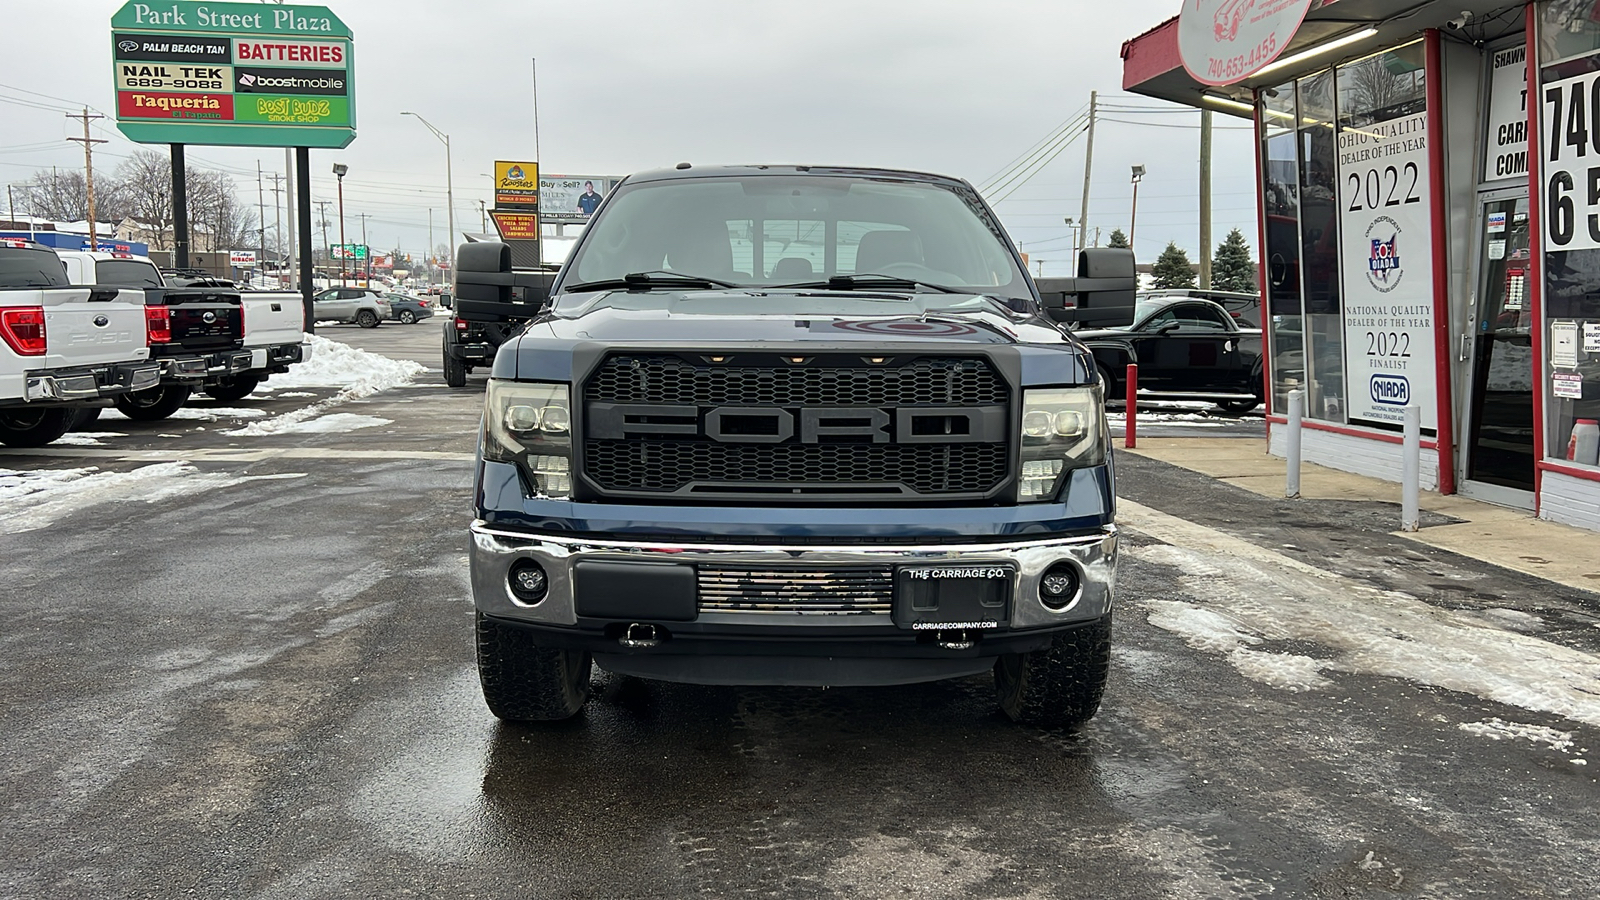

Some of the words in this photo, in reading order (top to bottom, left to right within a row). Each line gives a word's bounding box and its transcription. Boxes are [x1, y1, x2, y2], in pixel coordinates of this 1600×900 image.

[133, 3, 187, 25] Park
[196, 6, 263, 29] Street
[272, 9, 332, 32] Plaza
[142, 42, 169, 53] PALM
[170, 44, 204, 54] BEACH
[205, 45, 226, 55] TAN
[238, 43, 343, 63] BATTERIES
[123, 65, 171, 77] NAIL
[179, 67, 223, 79] TEK
[126, 78, 223, 89] 689-9088
[172, 110, 183, 118] El
[297, 115, 320, 123] SHOP
[1339, 133, 1368, 149] OHIO
[1372, 116, 1427, 143] QUALITY
[1341, 149, 1370, 166] DEALER
[1371, 146, 1383, 159] OF
[1383, 141, 1401, 156] THE
[1402, 136, 1426, 153] YEAR
[1348, 161, 1420, 212] 2022
[1371, 258, 1395, 270] OIADA
[1345, 305, 1388, 316] NATIONAL
[1391, 305, 1431, 317] QUALITY
[1347, 318, 1375, 327] DEALER
[1377, 318, 1388, 327] OF
[1390, 318, 1406, 327] THE
[1408, 318, 1431, 328] YEAR
[1366, 331, 1411, 357] 2022
[1370, 359, 1407, 370] FINALIST
[610, 401, 990, 444] FORD
[909, 570, 930, 579] THE
[931, 569, 986, 579] CARRIAGE
[987, 568, 1006, 578] CO.
[912, 621, 998, 630] CARRIAGECOMPANY.COM
